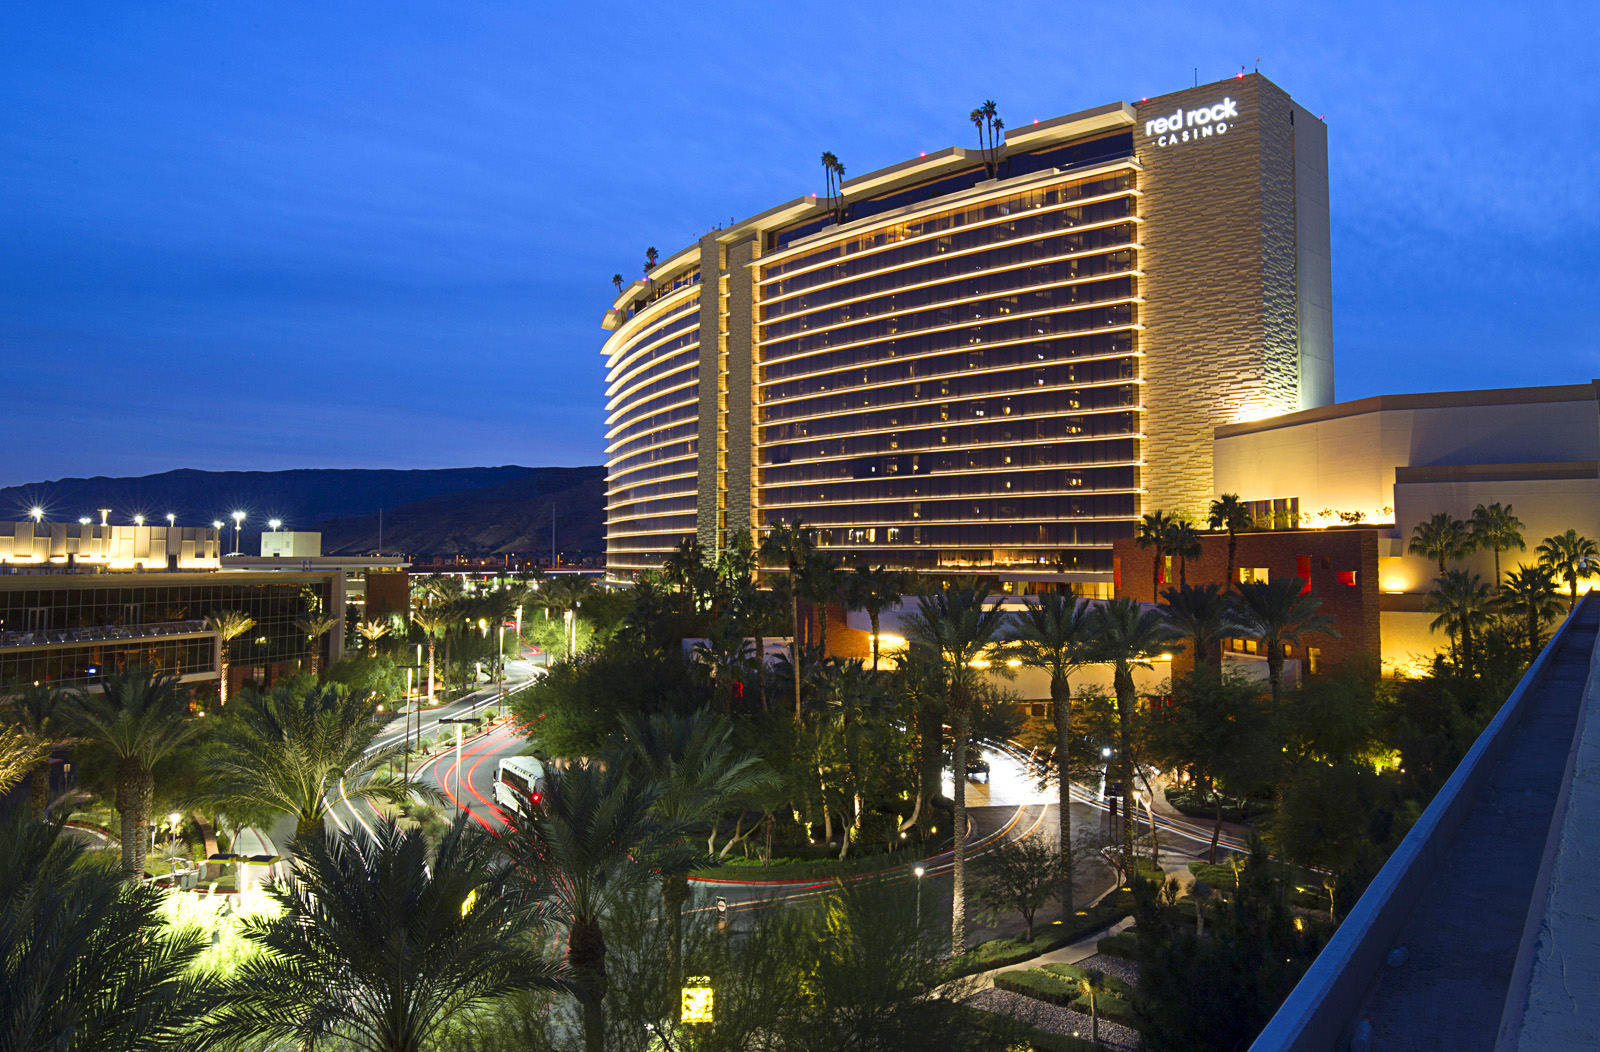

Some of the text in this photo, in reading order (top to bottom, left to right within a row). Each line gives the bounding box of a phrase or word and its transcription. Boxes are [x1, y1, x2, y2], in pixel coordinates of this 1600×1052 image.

[1145, 97, 1239, 137] red rock
[1157, 122, 1228, 147] CASINO
